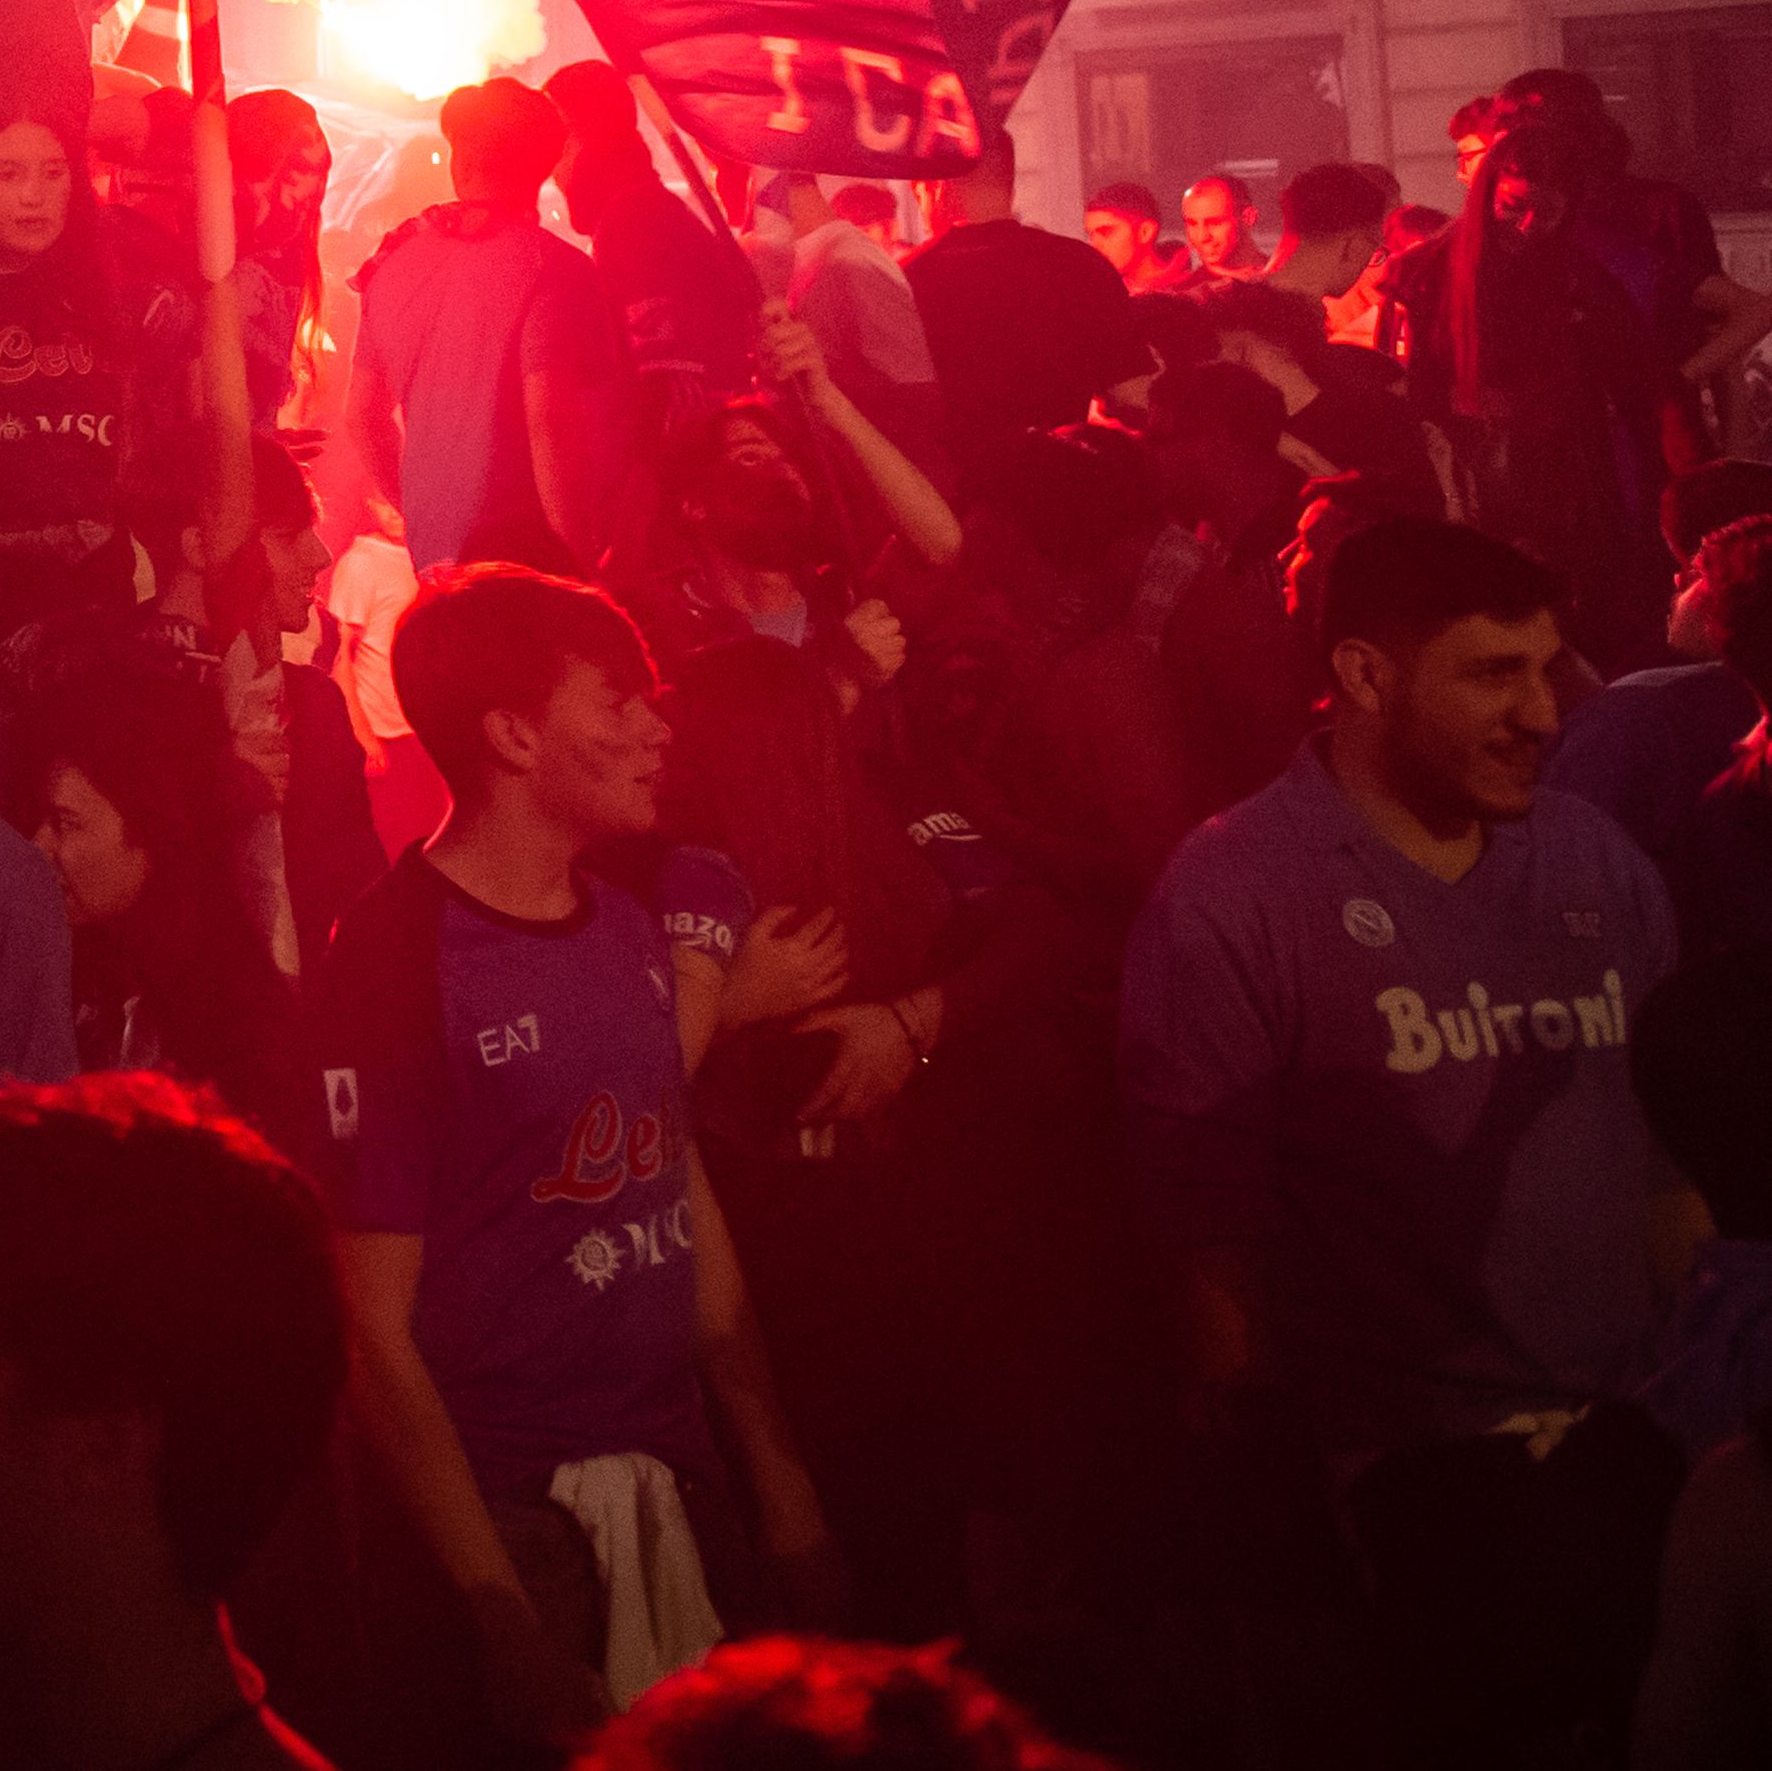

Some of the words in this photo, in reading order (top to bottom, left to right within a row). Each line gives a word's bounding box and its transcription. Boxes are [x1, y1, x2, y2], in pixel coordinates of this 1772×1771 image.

[35, 413, 115, 447] MSC
[477, 1012, 540, 1067] EA7
[1375, 966, 1626, 1074] Buitoni
